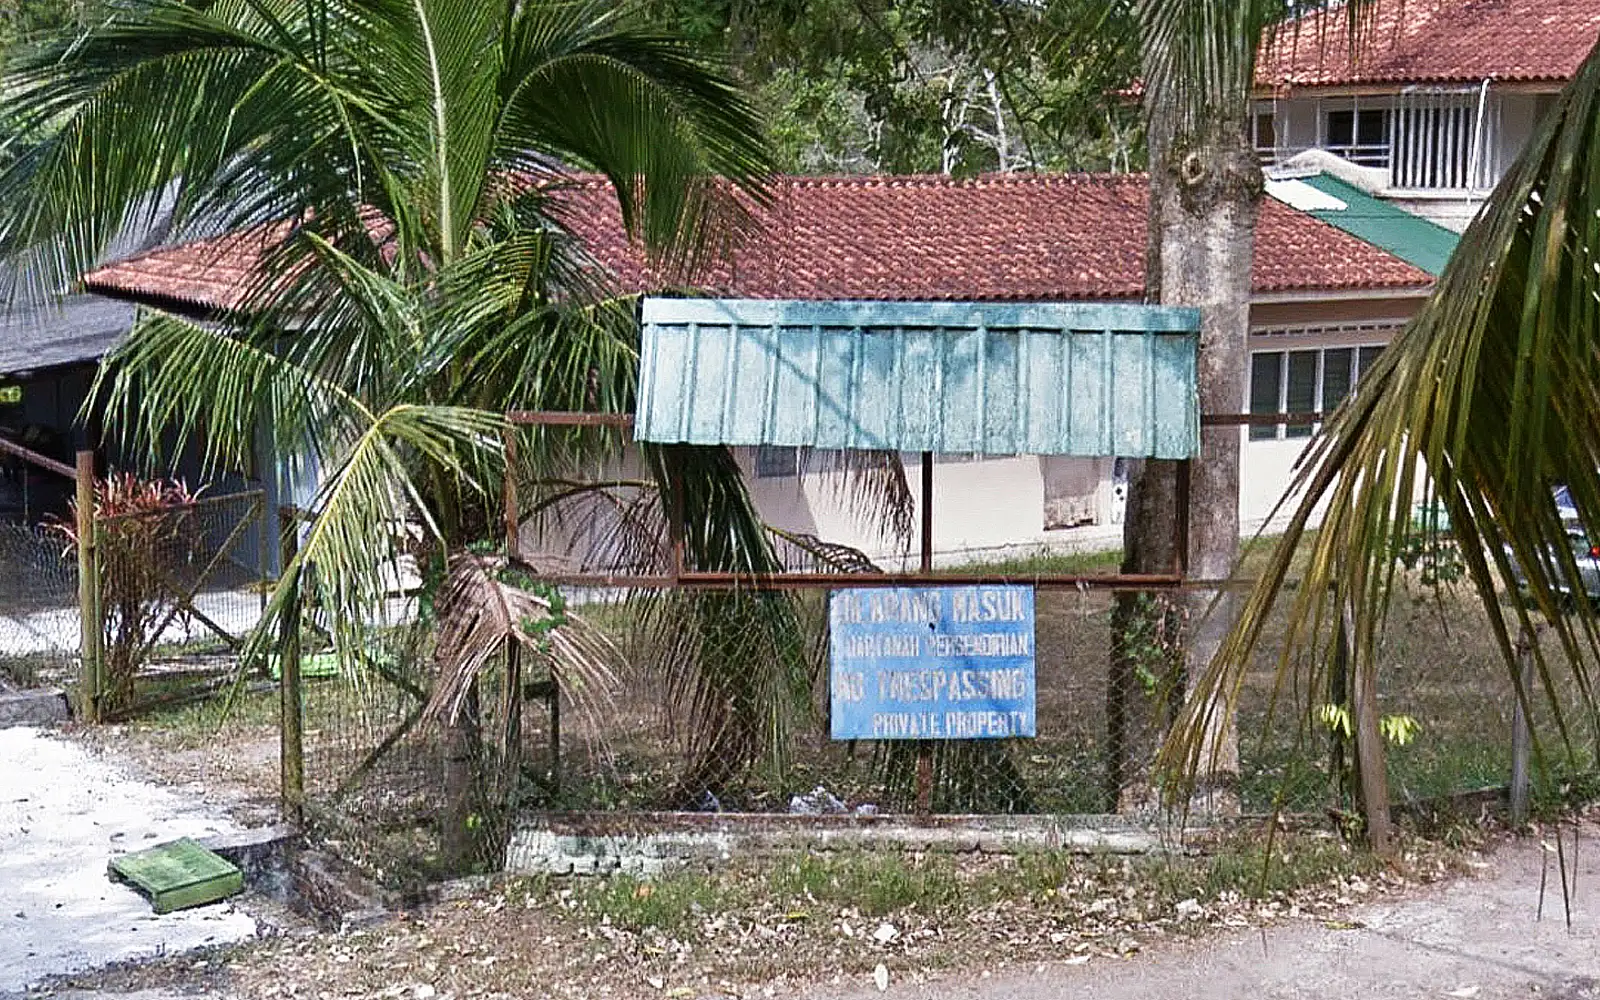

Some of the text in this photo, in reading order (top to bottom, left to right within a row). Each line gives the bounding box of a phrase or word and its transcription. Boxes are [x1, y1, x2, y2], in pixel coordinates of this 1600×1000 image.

[953, 590, 1025, 621] MASUK
[837, 669, 1025, 702] NO TRESPASSING
[873, 711, 1027, 736] PRIVATE PROPERTY
